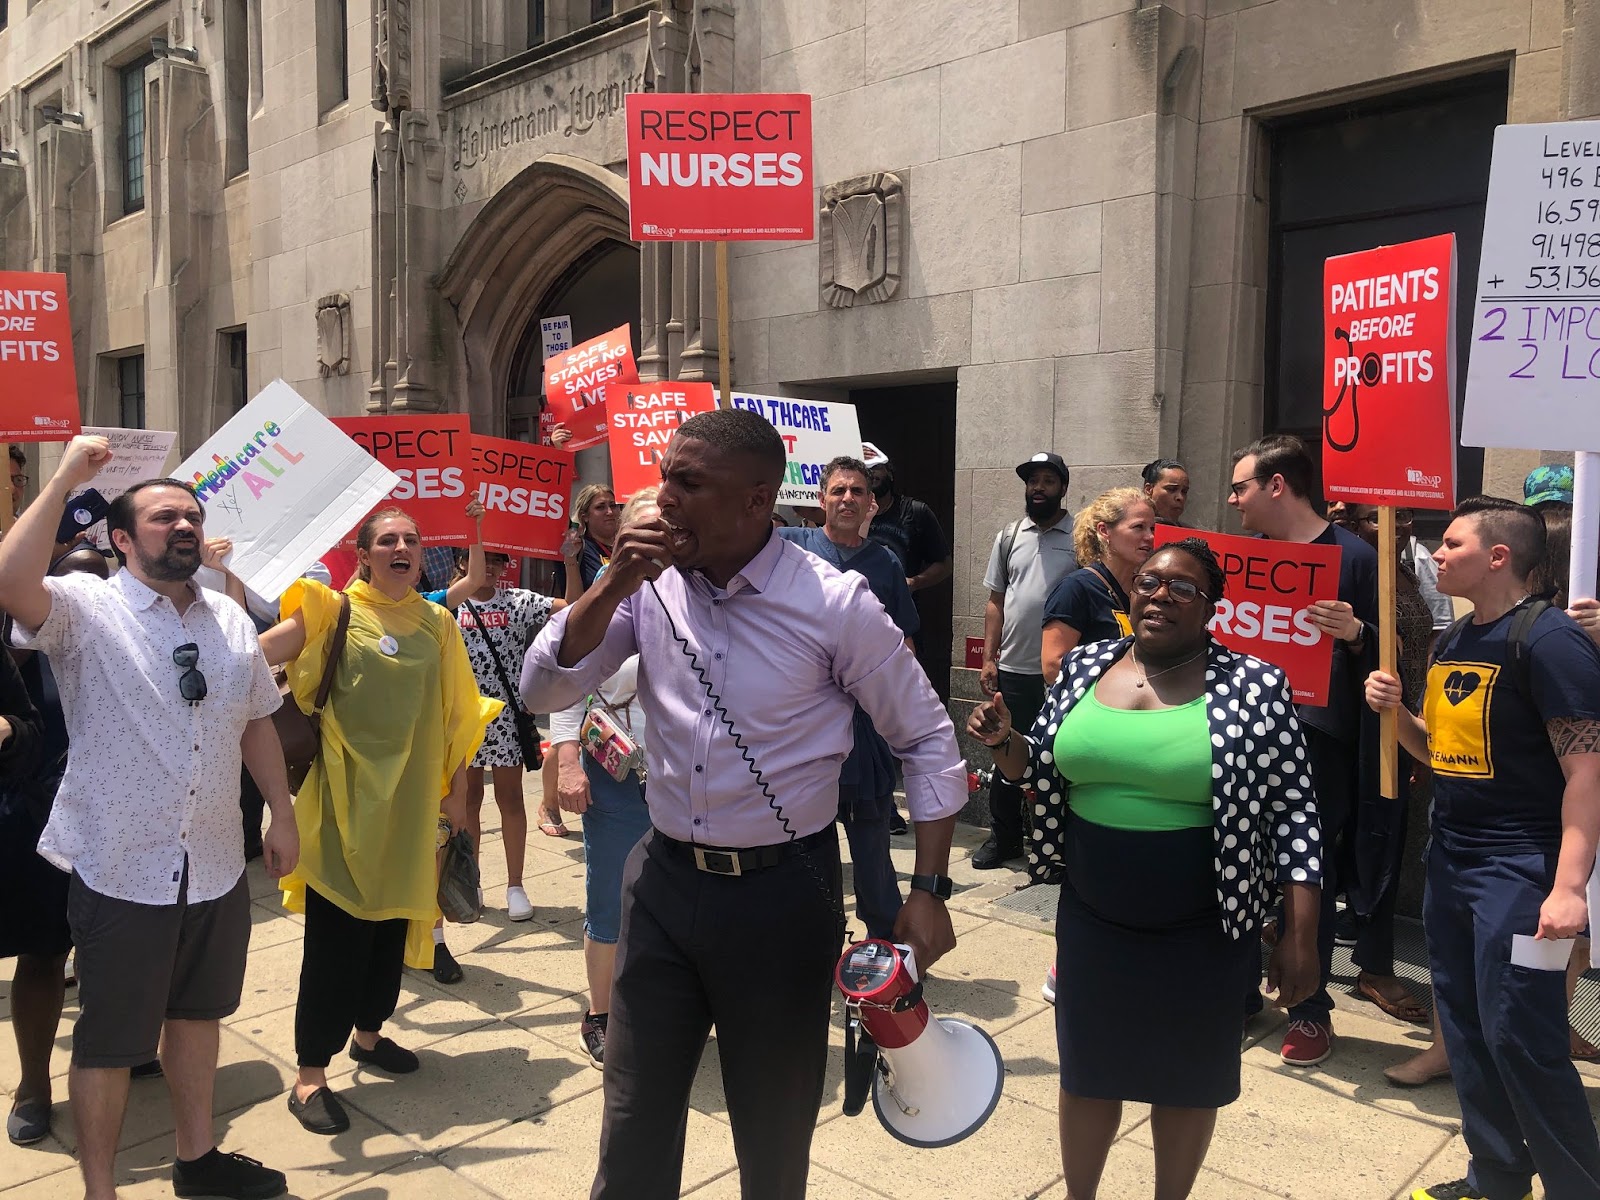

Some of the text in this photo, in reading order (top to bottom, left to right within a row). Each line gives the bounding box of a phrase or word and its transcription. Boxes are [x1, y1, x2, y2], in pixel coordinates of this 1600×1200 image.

[640, 109, 801, 142] RESPECT
[640, 152, 804, 187] NURSES
[1541, 166, 1583, 189] 496
[1537, 198, 1600, 225] 16,59
[0, 289, 58, 311] NTS
[1331, 266, 1439, 314] PATIENTS
[543, 320, 569, 332] BE FAIR
[552, 332, 561, 341] TO
[1349, 312, 1416, 342] BEFORE
[1480, 307, 1507, 341] 2
[546, 342, 568, 352] THOSE
[567, 341, 609, 364] SAFE
[1509, 343, 1538, 378] 2
[564, 364, 618, 394] SAVES
[1334, 349, 1434, 387] PROFITS
[635, 392, 687, 409] SAFE
[717, 398, 831, 432] EALTHCARE
[633, 429, 677, 446] SAV
[186, 421, 281, 503] Medicare
[241, 442, 305, 501] ALL
